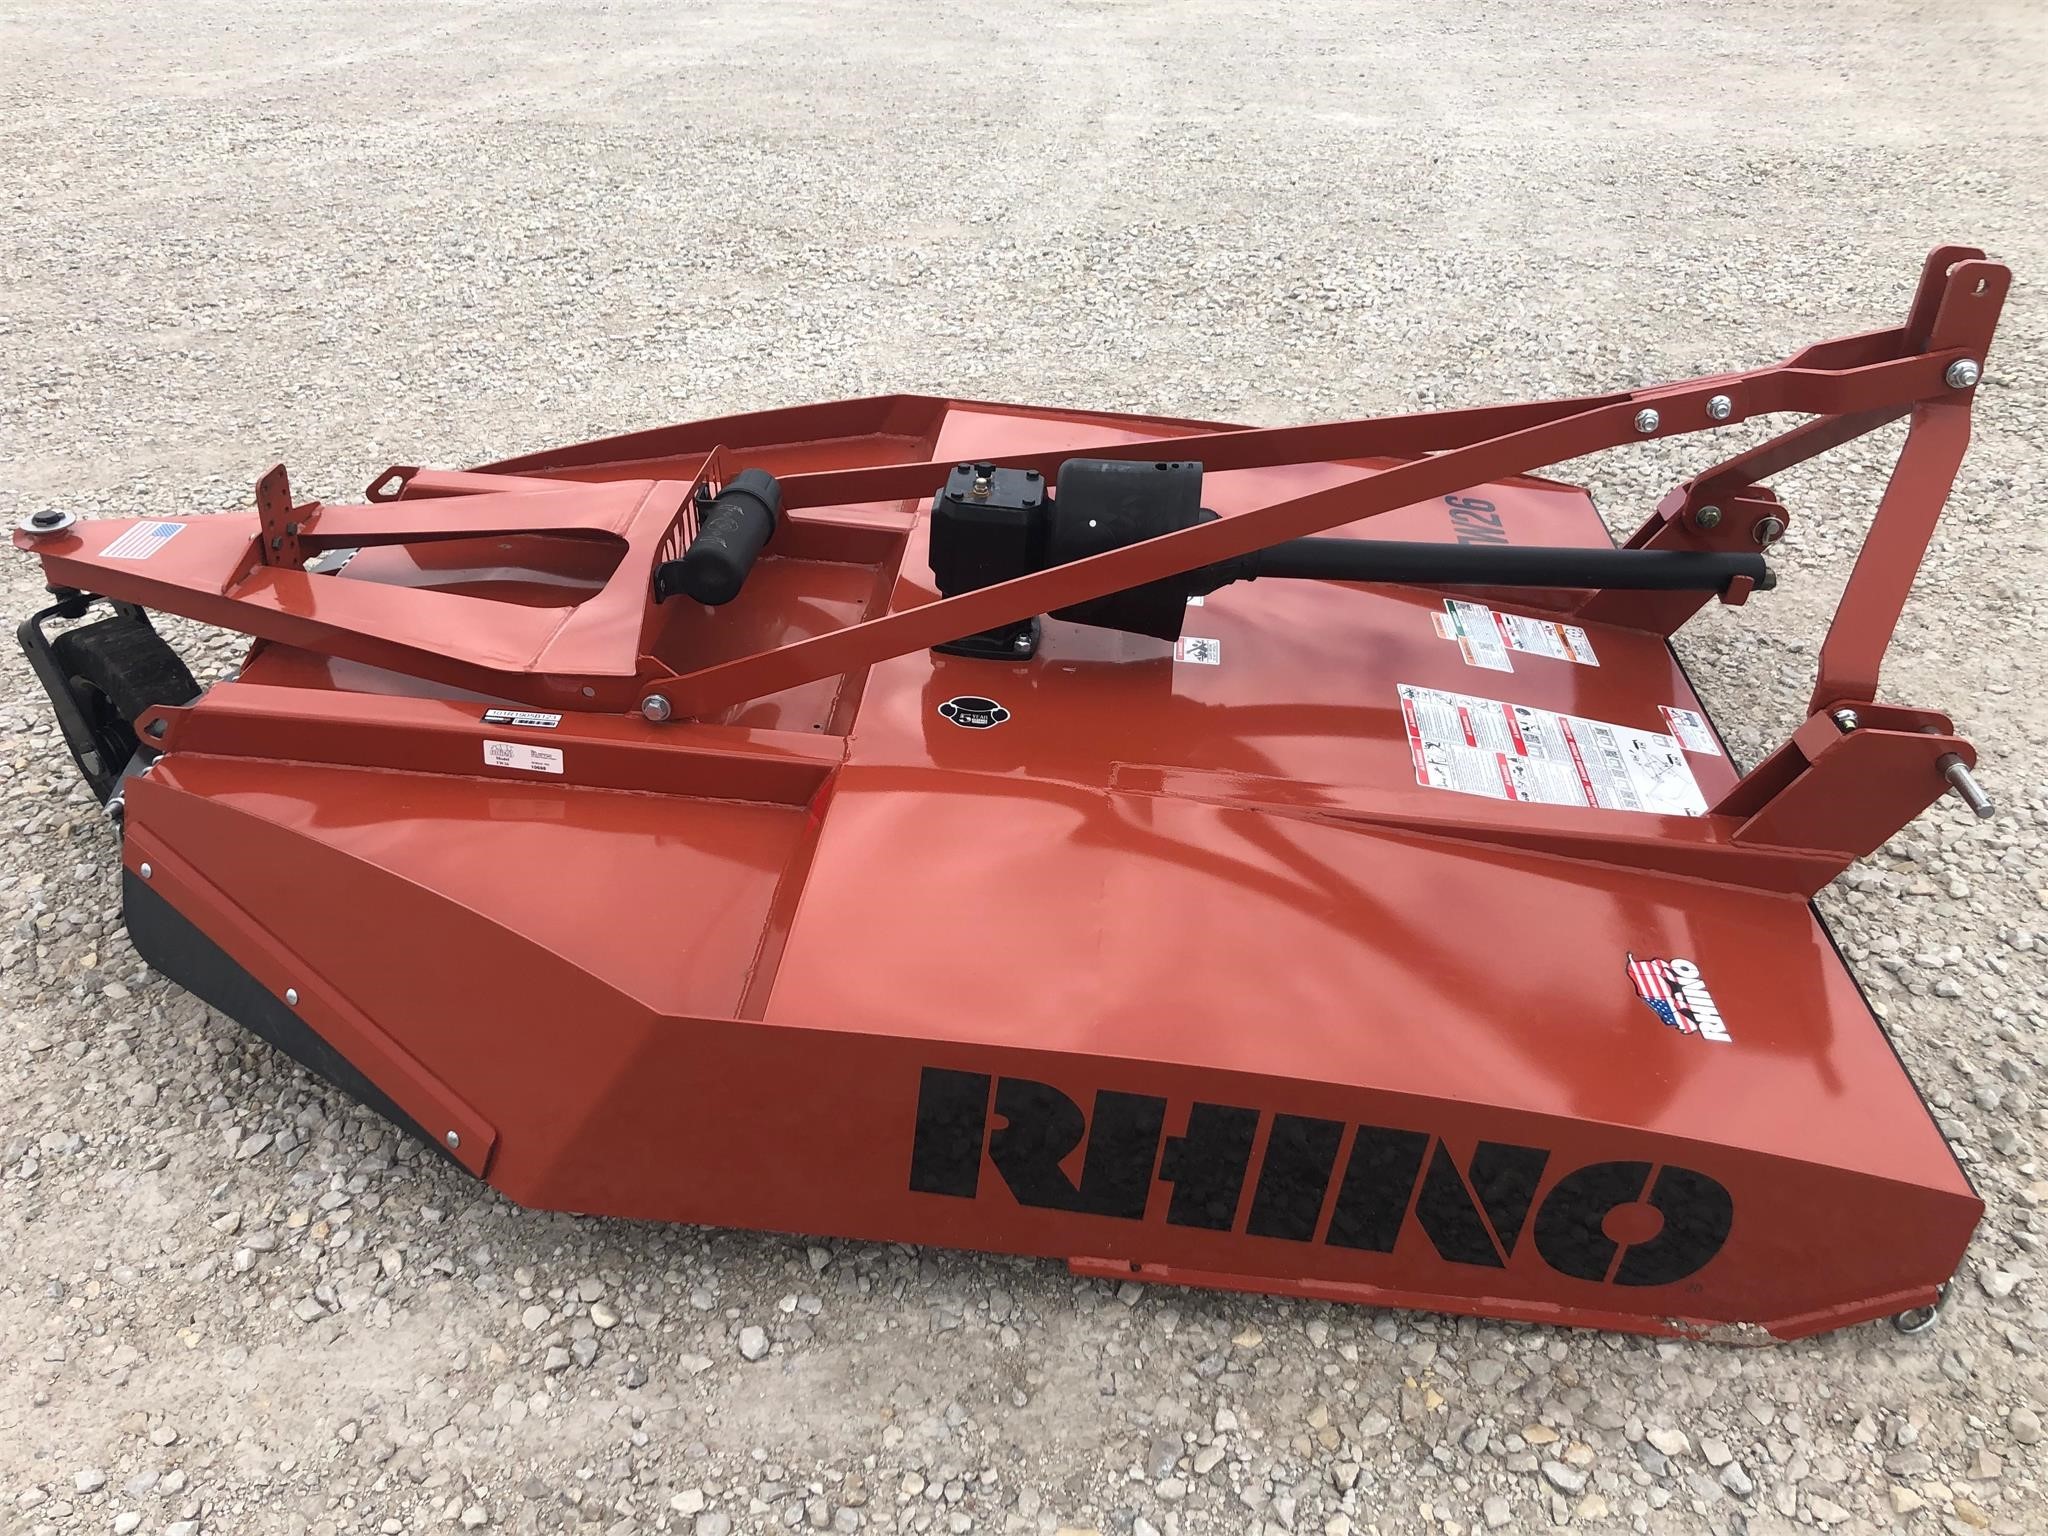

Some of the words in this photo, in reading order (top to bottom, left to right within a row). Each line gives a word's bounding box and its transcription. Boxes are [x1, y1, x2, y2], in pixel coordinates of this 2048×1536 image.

[1444, 495, 1508, 544] W26
[1670, 958, 1732, 1042] RHINO
[909, 1066, 1734, 1286] RHINO
